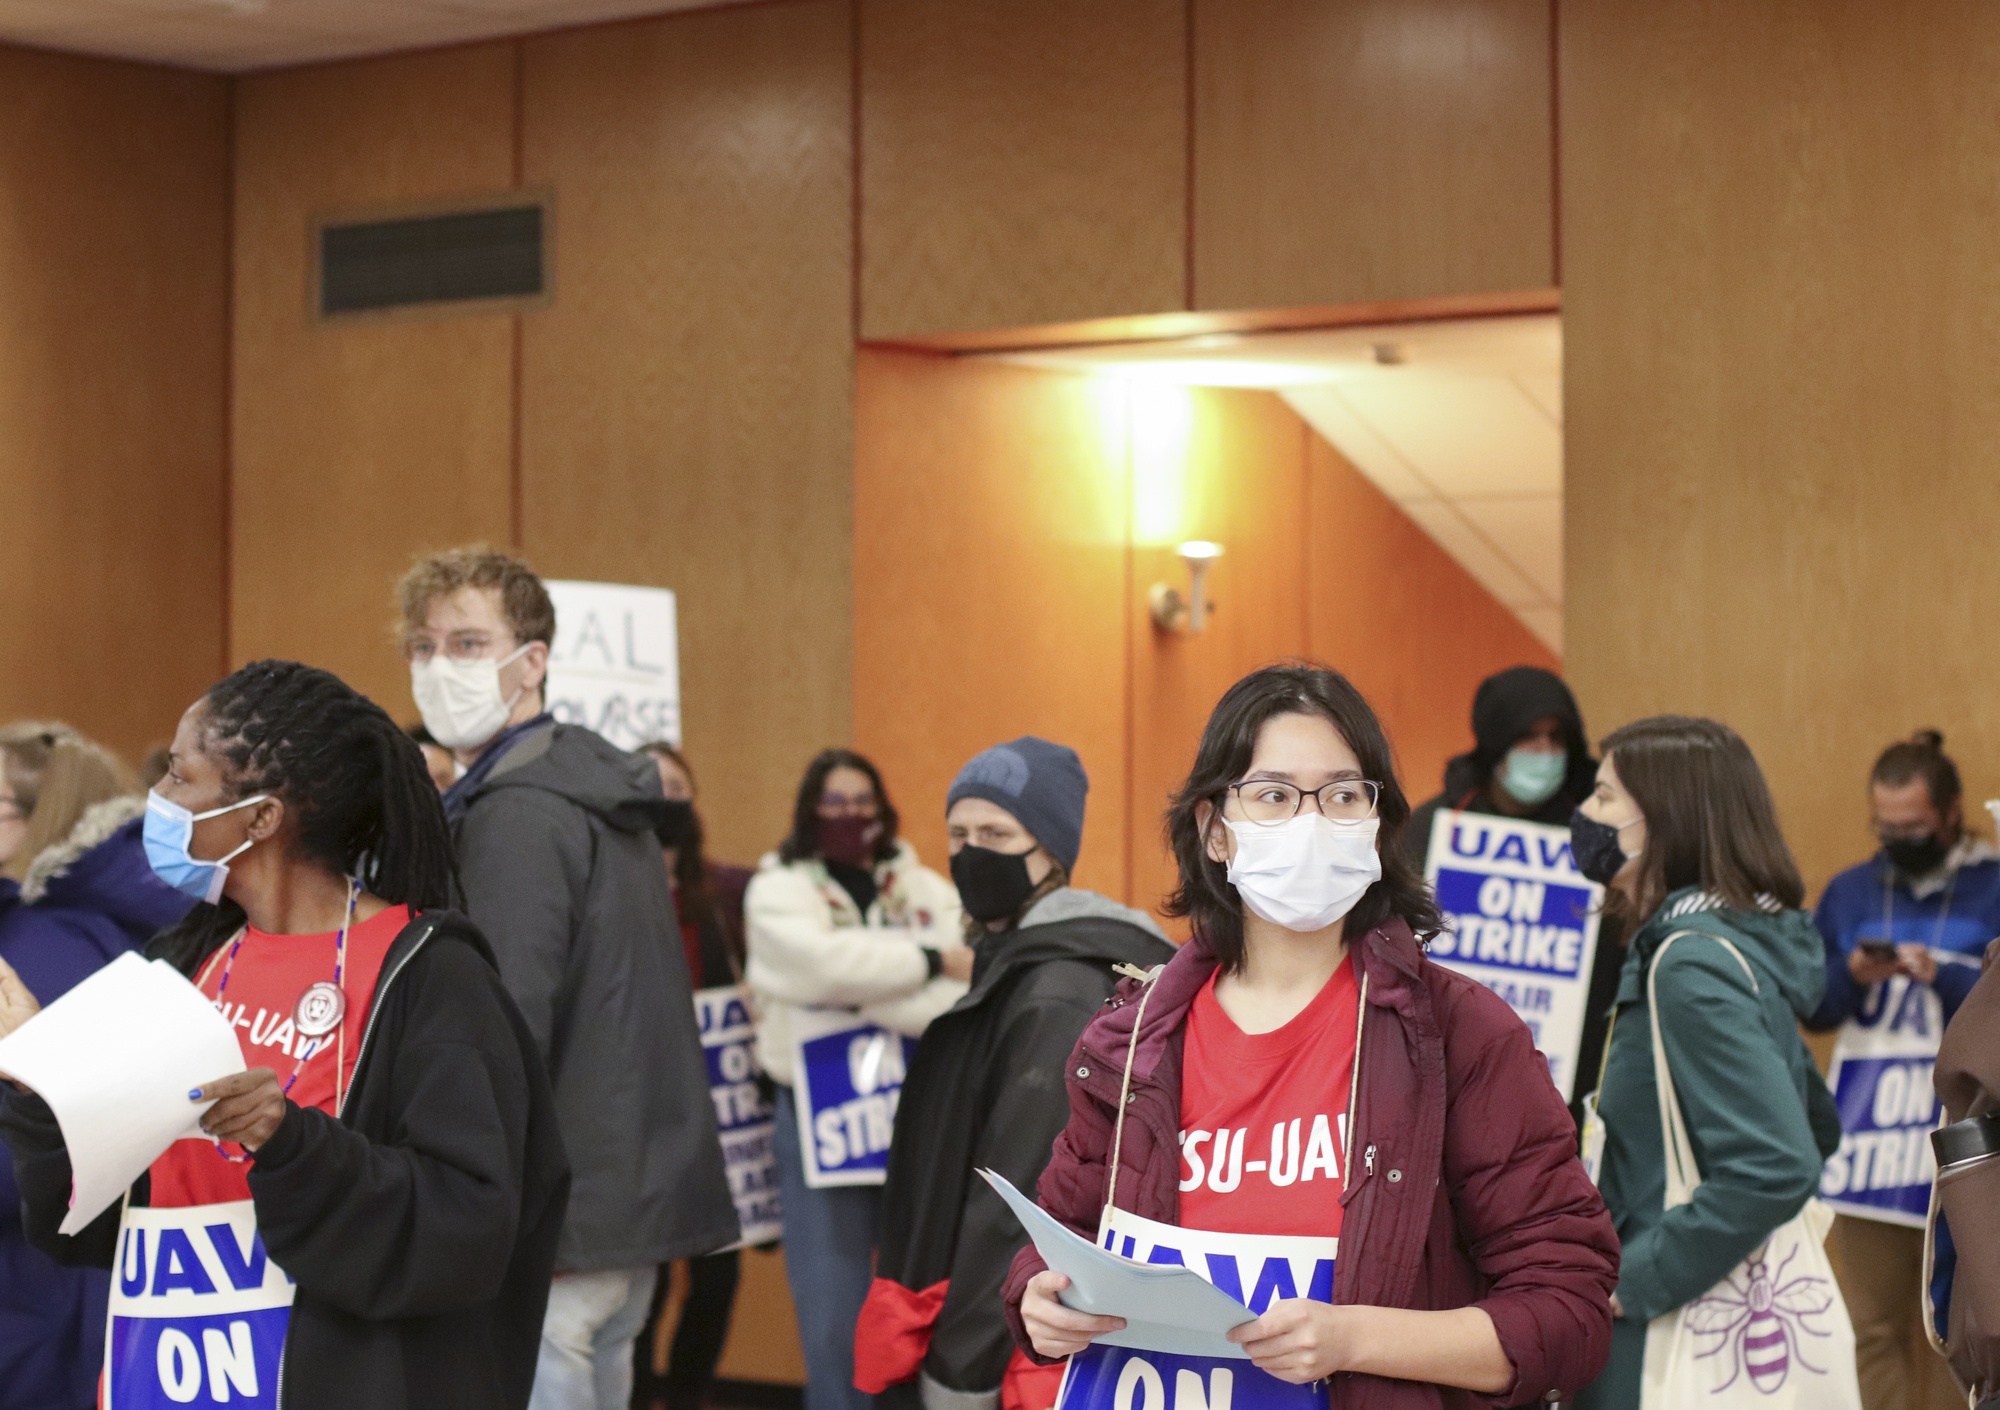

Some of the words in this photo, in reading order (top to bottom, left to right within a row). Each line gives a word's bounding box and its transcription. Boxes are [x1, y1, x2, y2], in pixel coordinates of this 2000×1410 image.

[553, 610, 664, 675] AL
[1478, 876, 1546, 922] ON
[1431, 909, 1580, 972] STRIKE
[1872, 1064, 1935, 1128] ON
[1178, 1113, 1346, 1193] SU-UA
[156, 1321, 259, 1403] ON
[1113, 1357, 1234, 1410] ON
